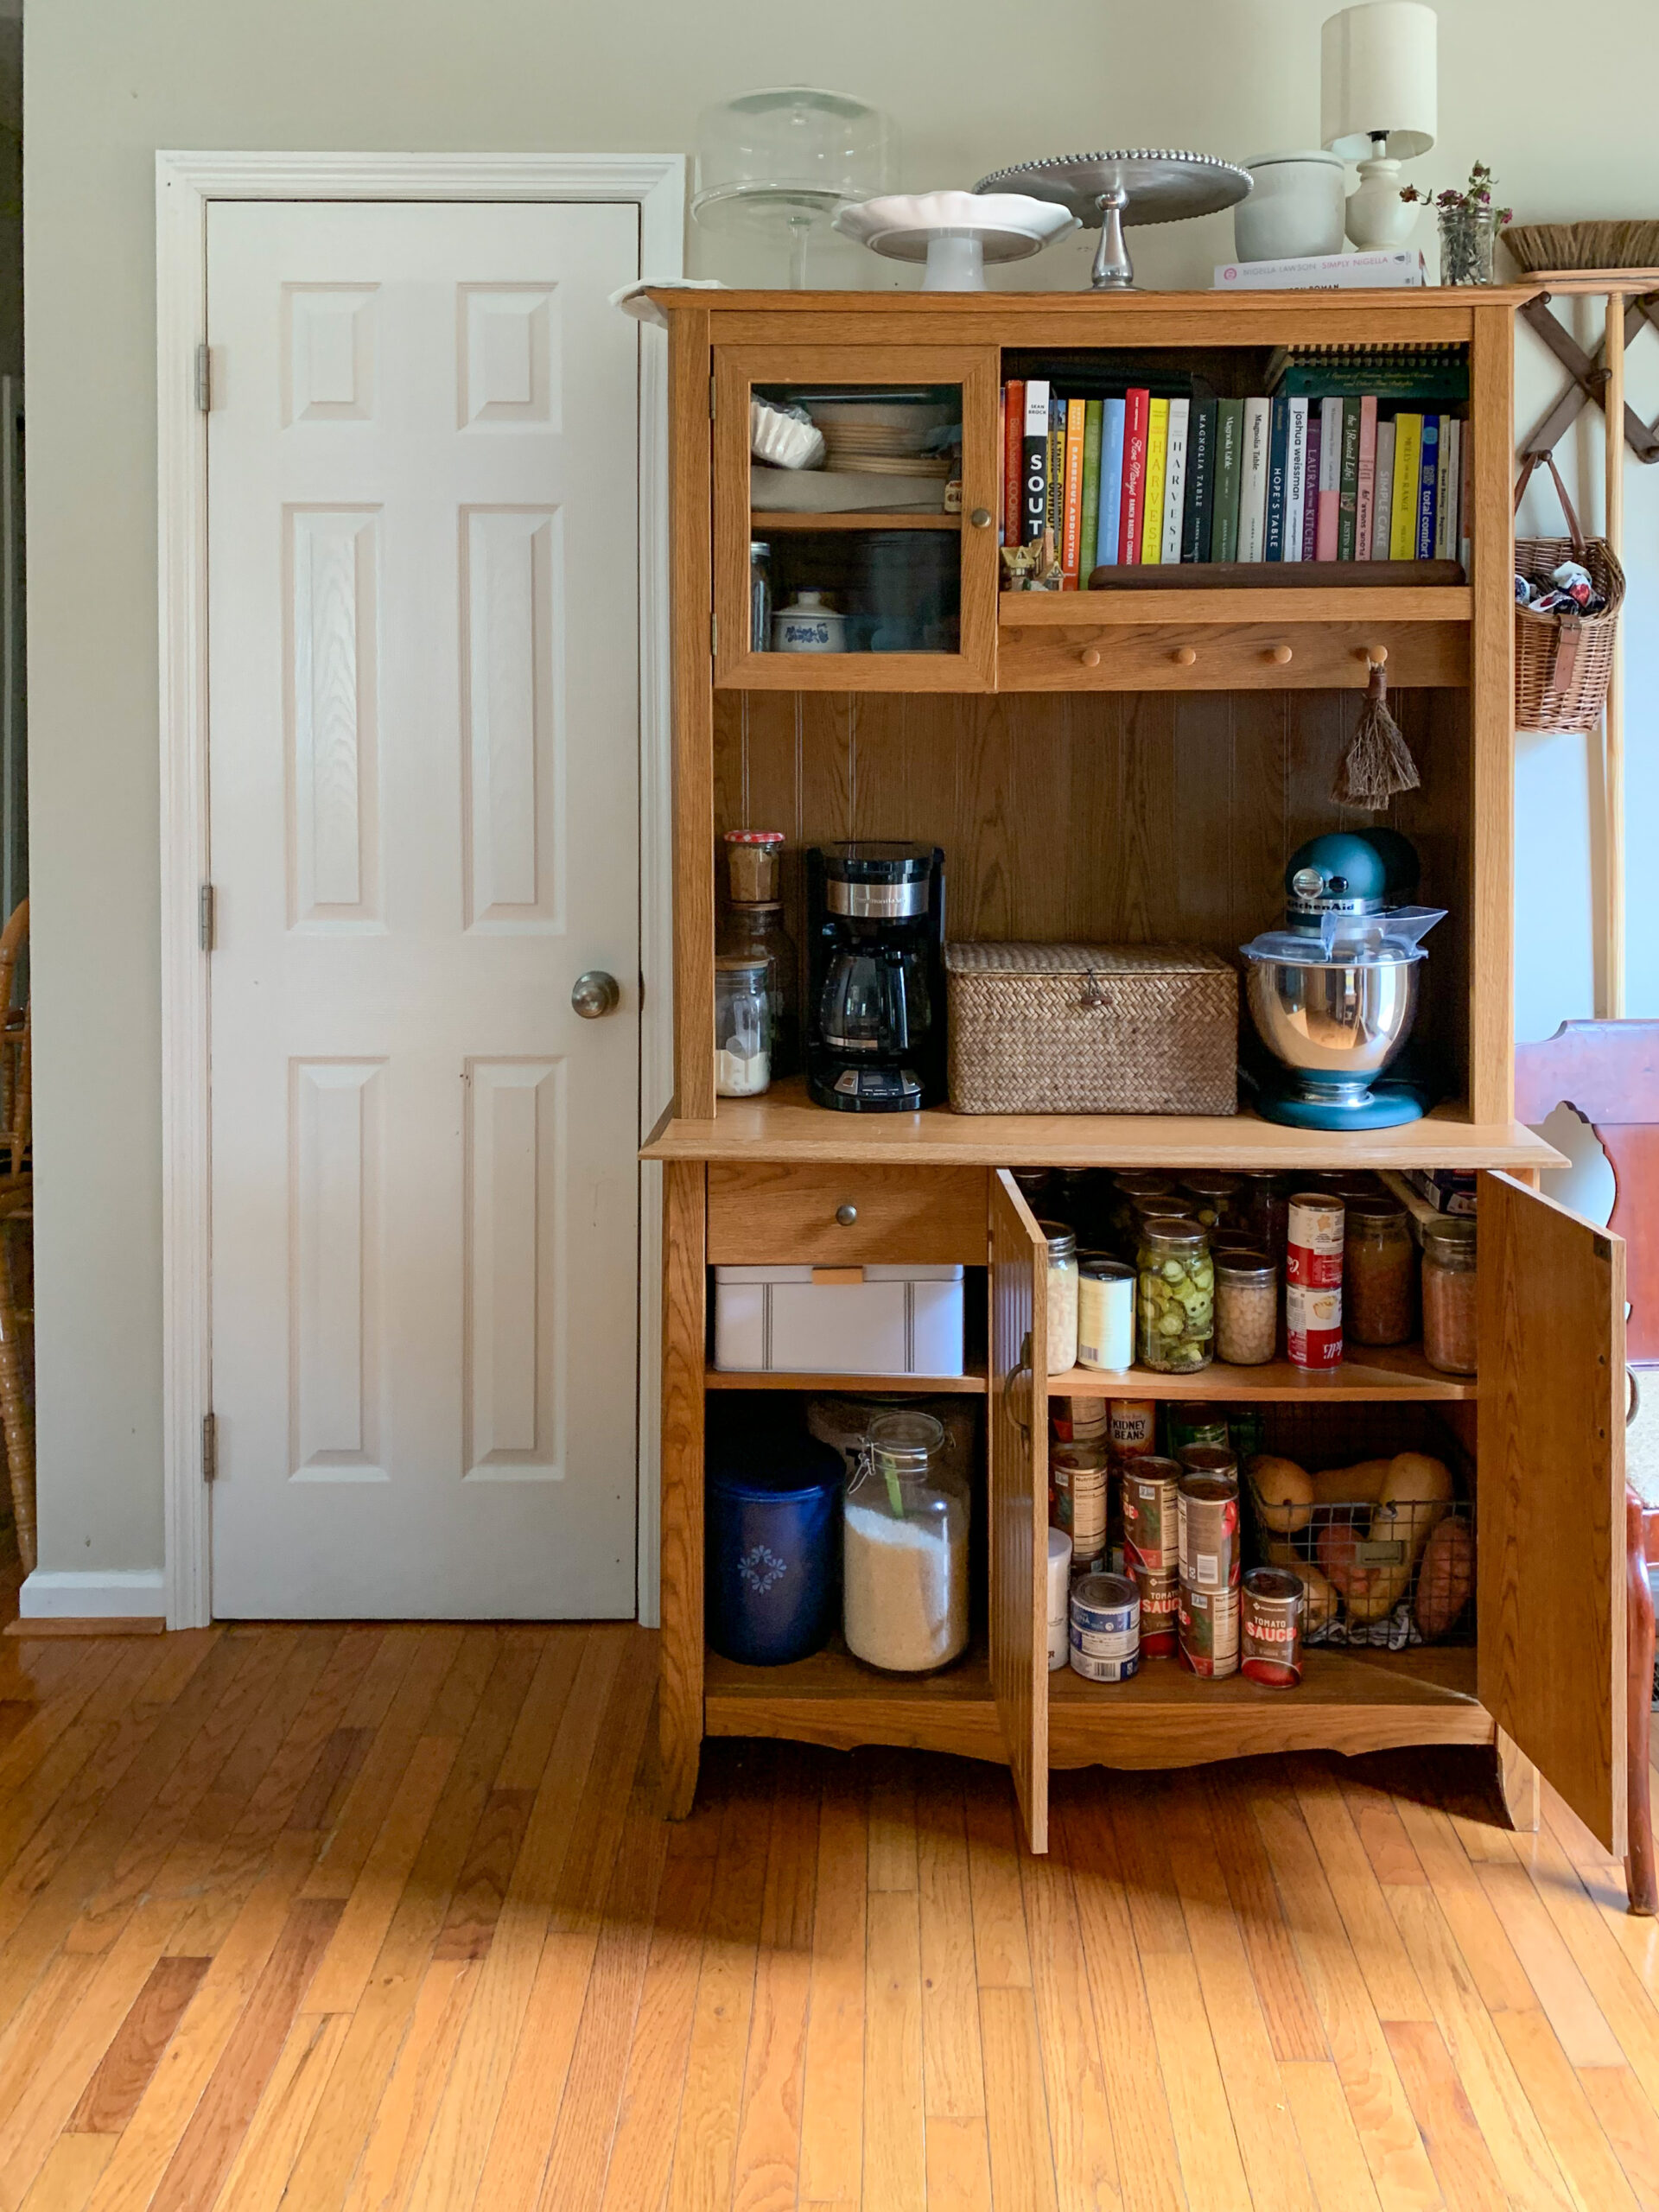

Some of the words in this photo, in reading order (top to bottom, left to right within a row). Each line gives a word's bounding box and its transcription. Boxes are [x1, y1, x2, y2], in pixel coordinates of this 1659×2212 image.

[1243, 266, 1276, 276] NIGELLA
[1280, 263, 1317, 273] LAWSON
[1322, 260, 1351, 270] SIMPLY
[1353, 256, 1389, 267] NIGELLA
[1224, 416, 1235, 449] Magnolia
[1253, 414, 1262, 448] Magnolia
[1292, 410, 1305, 446] joshua
[1347, 414, 1357, 427] the
[1196, 414, 1207, 470] MAGNOLIA
[1070, 446, 1079, 505] BARBECUE
[1252, 450, 1261, 471] Table
[1293, 448, 1303, 500] weissman
[1306, 448, 1318, 490] LAURA
[1027, 454, 1046, 543] SOUT
[1147, 439, 1163, 558] HARVEST
[1169, 440, 1183, 553] HARVEST
[1195, 474, 1204, 507] TABLE
[1272, 467, 1282, 509] HOPE'S
[1378, 470, 1390, 512] SIMPLE
[1401, 482, 1411, 512] RANGE
[1422, 490, 1433, 515] total
[1008, 480, 1019, 545] COOKBOOK
[1067, 506, 1077, 568] ADDICTION
[1269, 513, 1280, 548] TABLE
[1303, 508, 1316, 562] KITCHEN
[1343, 520, 1351, 546] JUSTIN
[1376, 515, 1388, 547] CAKE
[1421, 516, 1432, 559] comfort
[1287, 900, 1355, 912] KitchenAid
[1112, 1420, 1146, 1430] KIDNEY
[1114, 1429, 1146, 1440] BEANS
[1246, 1621, 1294, 1643] SAUCE
[1254, 1616, 1287, 1629] TOMATO
